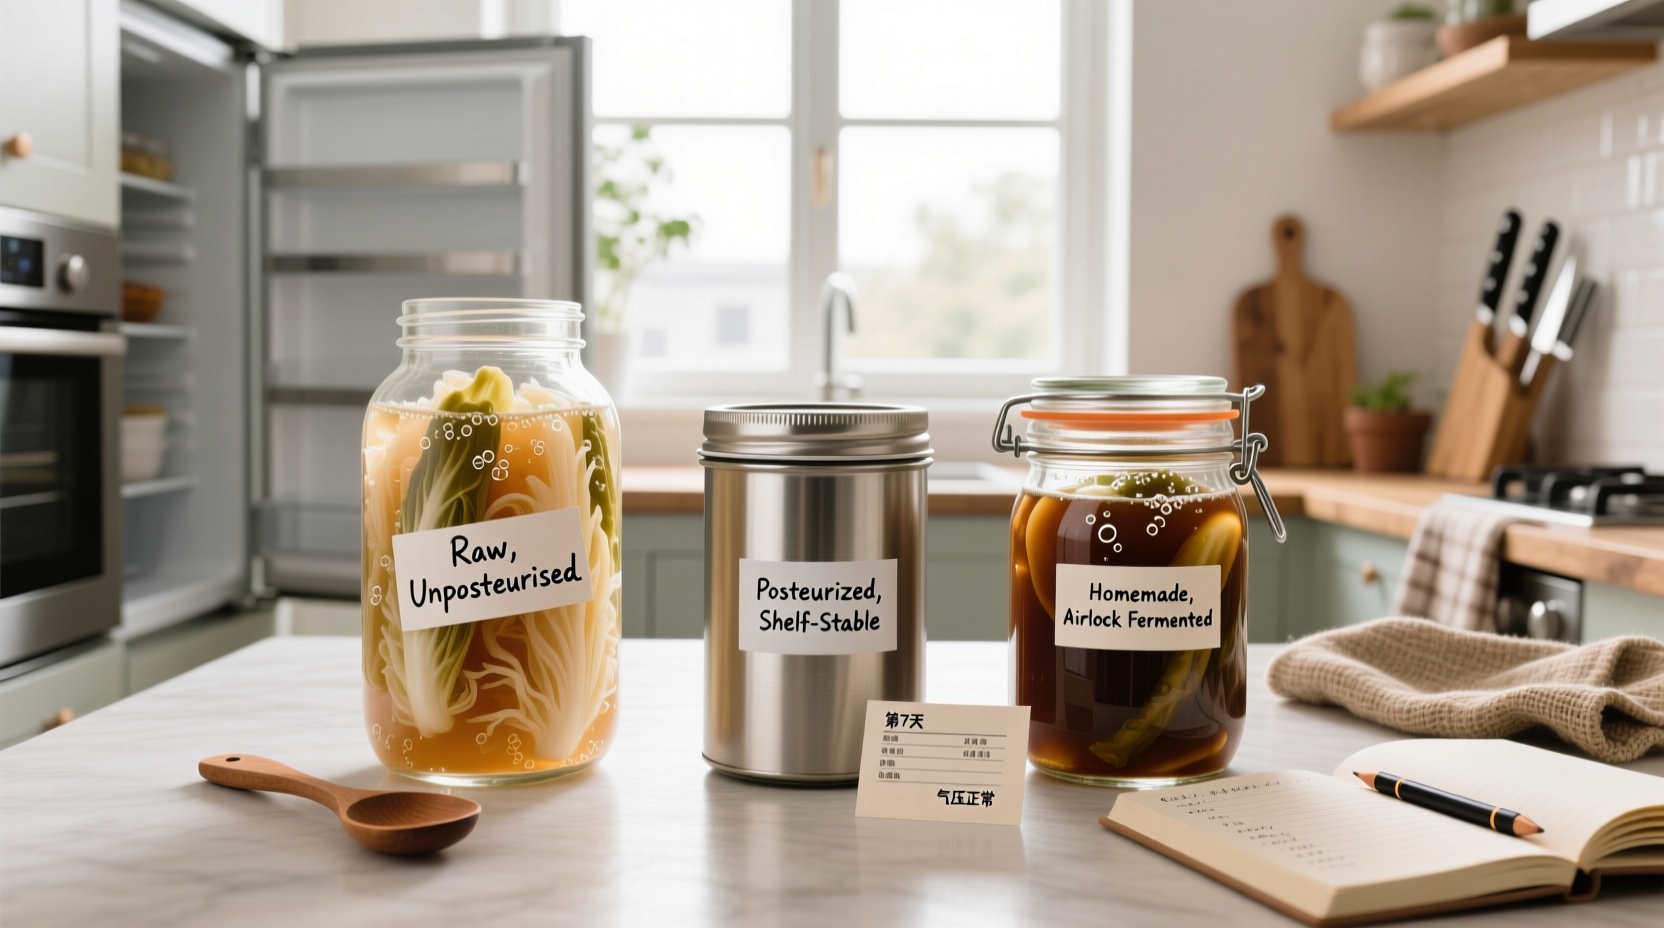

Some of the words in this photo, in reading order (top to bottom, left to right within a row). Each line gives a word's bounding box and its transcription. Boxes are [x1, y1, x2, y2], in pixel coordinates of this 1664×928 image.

[450, 535, 516, 567] Raw,
[409, 552, 582, 613] Unposteurised
[757, 577, 881, 604] Posteurized,
[1089, 582, 1193, 605] Homemade,
[759, 609, 880, 633] Shelf-Stable
[1063, 607, 1122, 628] Airlock
[1128, 608, 1212, 628] Fermented
[885, 711, 924, 729] 第7天
[937, 788, 995, 808] 气压正常
